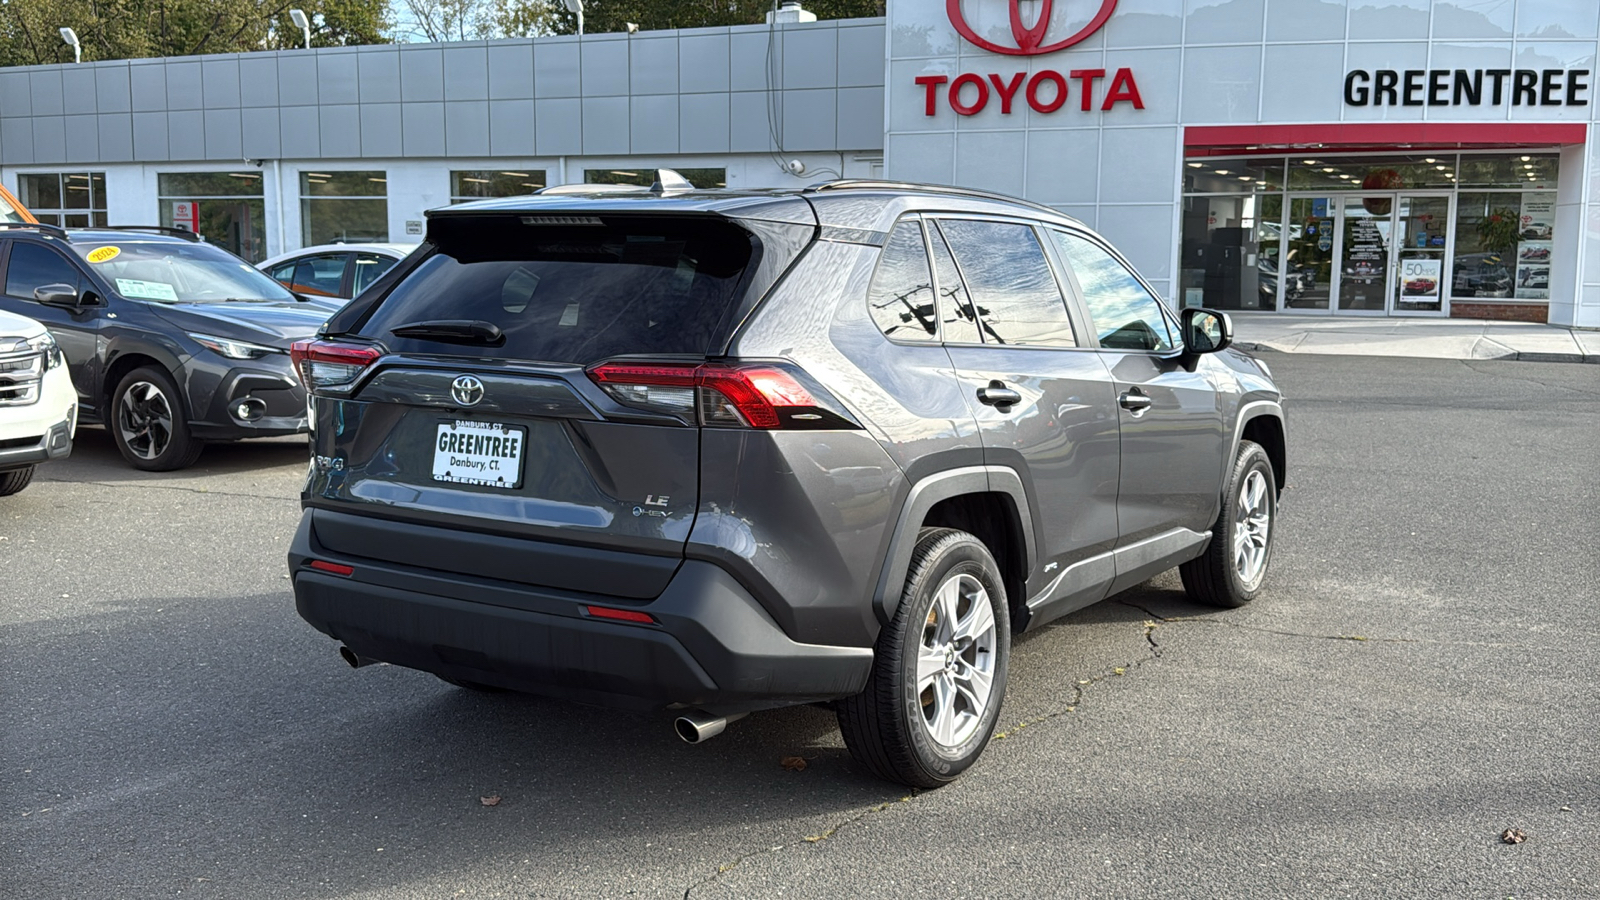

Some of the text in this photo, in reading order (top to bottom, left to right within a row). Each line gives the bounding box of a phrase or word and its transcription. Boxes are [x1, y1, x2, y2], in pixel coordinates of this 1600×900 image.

[915, 68, 1145, 116] TOYOTA
[1344, 69, 1590, 106] GREENTREE
[93, 247, 116, 261] 2024
[1406, 263, 1423, 276] 50
[455, 420, 492, 430] DANBURY,
[438, 431, 518, 458] GREENTREE
[450, 456, 500, 472] Danbury, CT.
[433, 474, 514, 488] GREENTREE
[645, 494, 670, 507] LE
